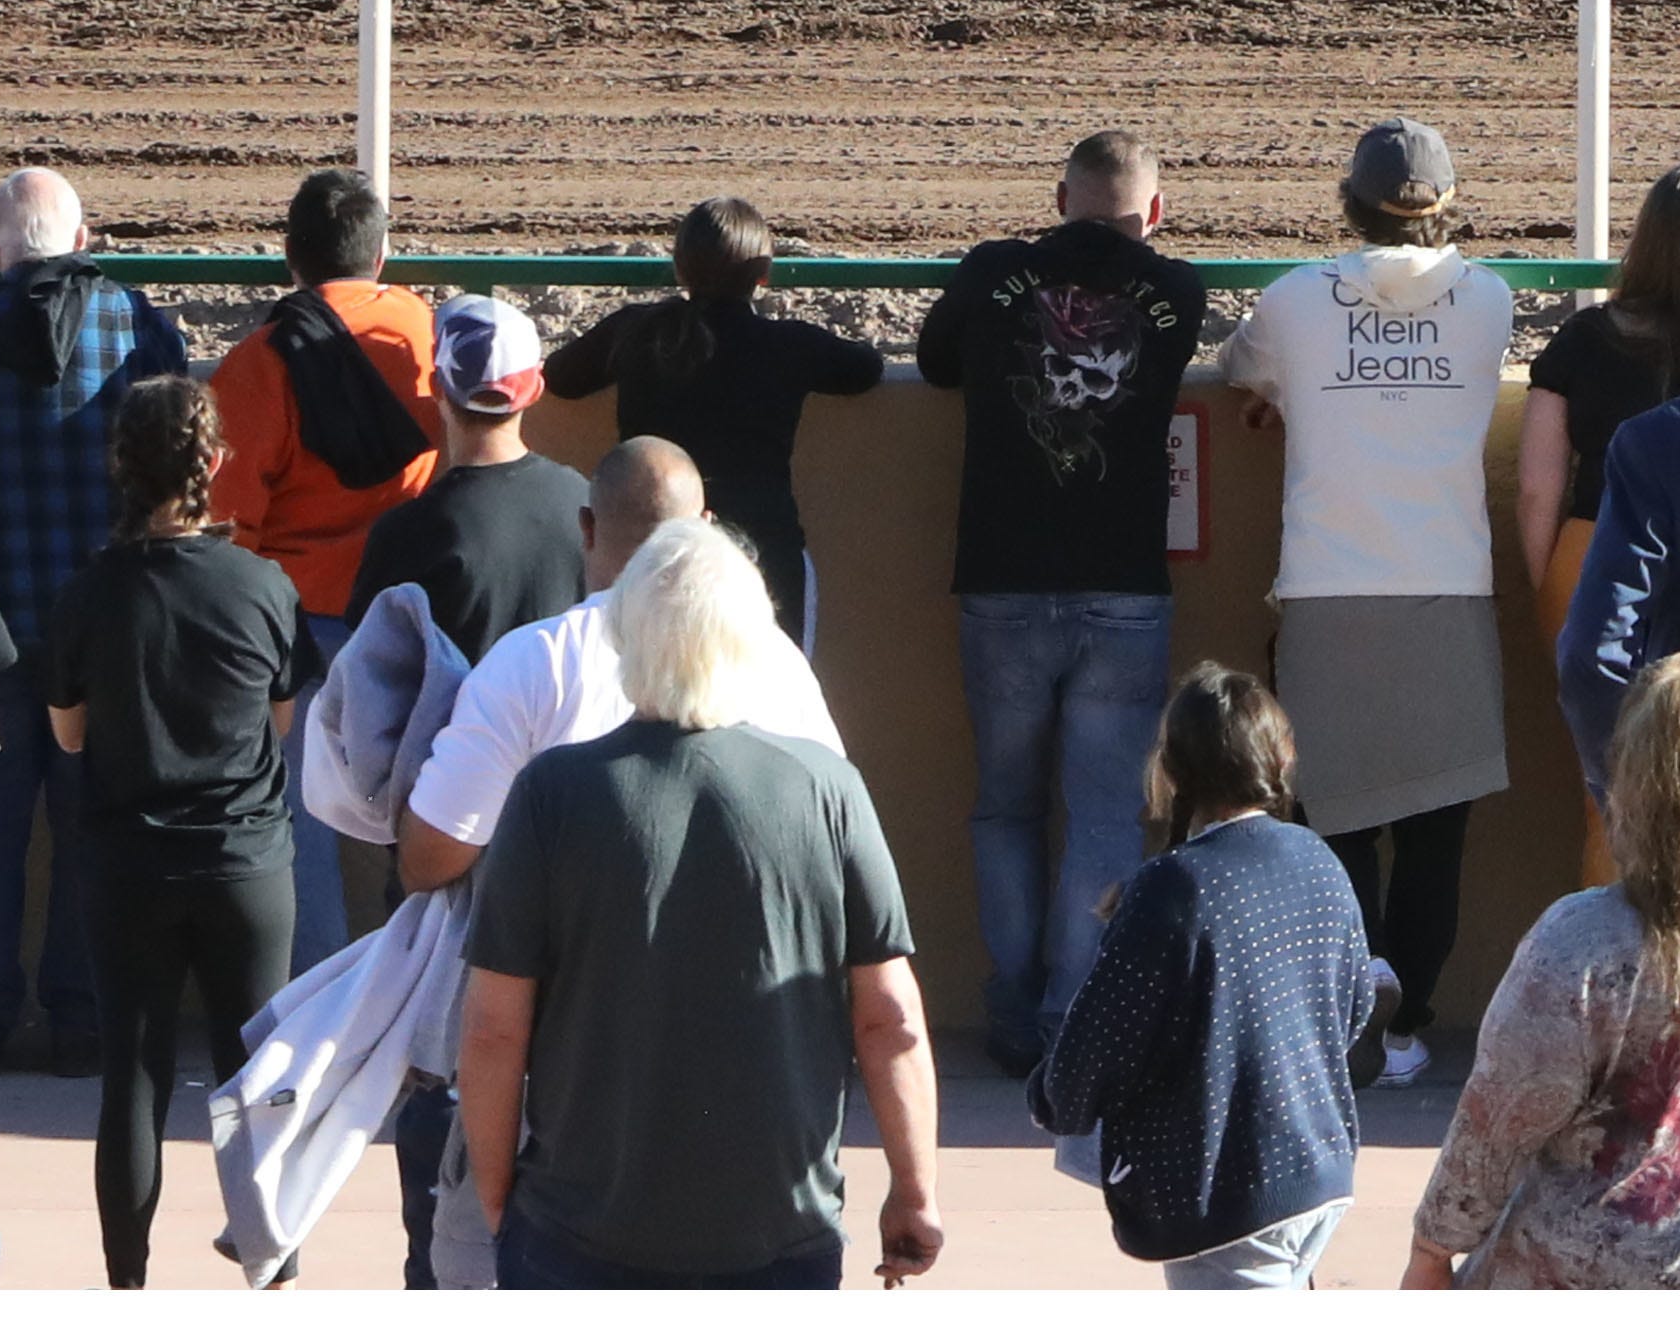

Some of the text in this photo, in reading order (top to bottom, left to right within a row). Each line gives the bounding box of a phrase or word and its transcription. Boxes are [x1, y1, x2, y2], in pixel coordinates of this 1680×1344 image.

[1347, 310, 1439, 345] Klein
[1335, 347, 1452, 383] Jeans
[1380, 391, 1408, 402] NYC
